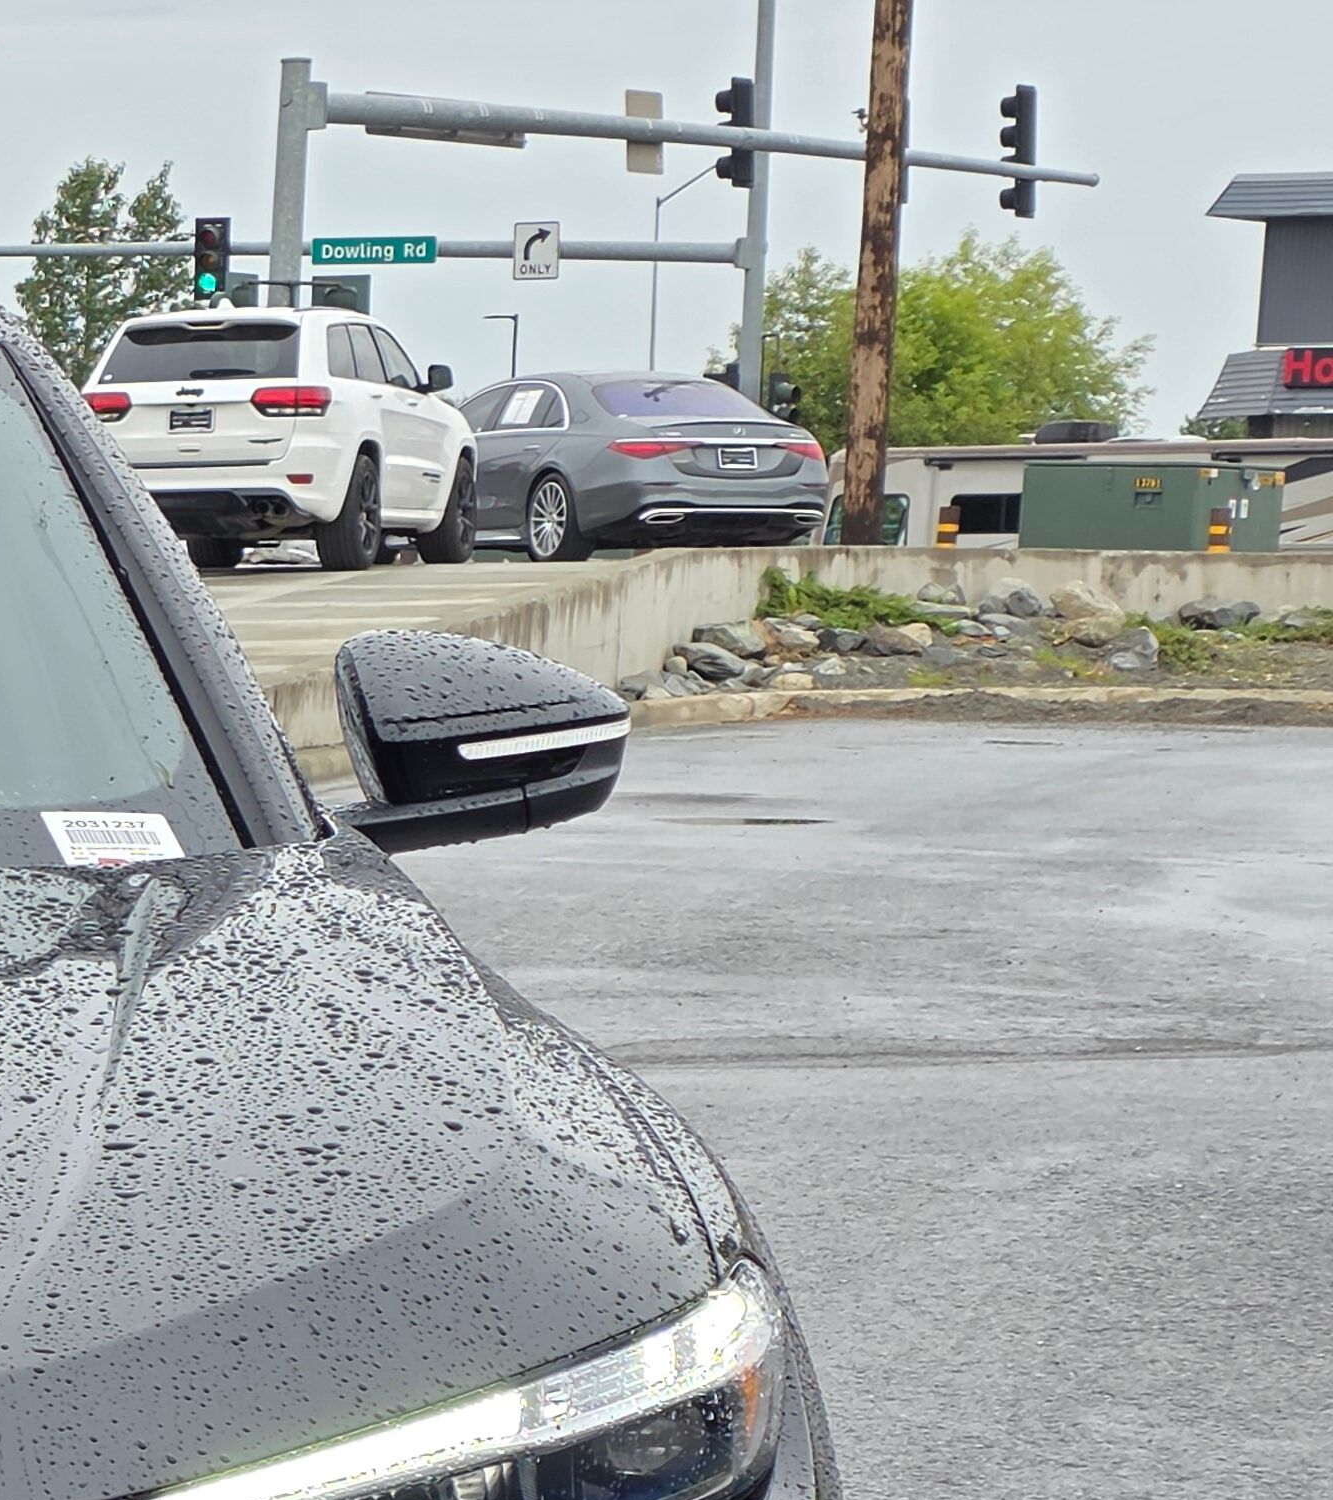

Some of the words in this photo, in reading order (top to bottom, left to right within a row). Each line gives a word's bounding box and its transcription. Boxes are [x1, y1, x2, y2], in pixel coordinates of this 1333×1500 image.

[321, 242, 395, 262] Dowling
[403, 242, 427, 258] Rd
[519, 263, 552, 276] ONLY
[62, 819, 146, 829] 2031237
